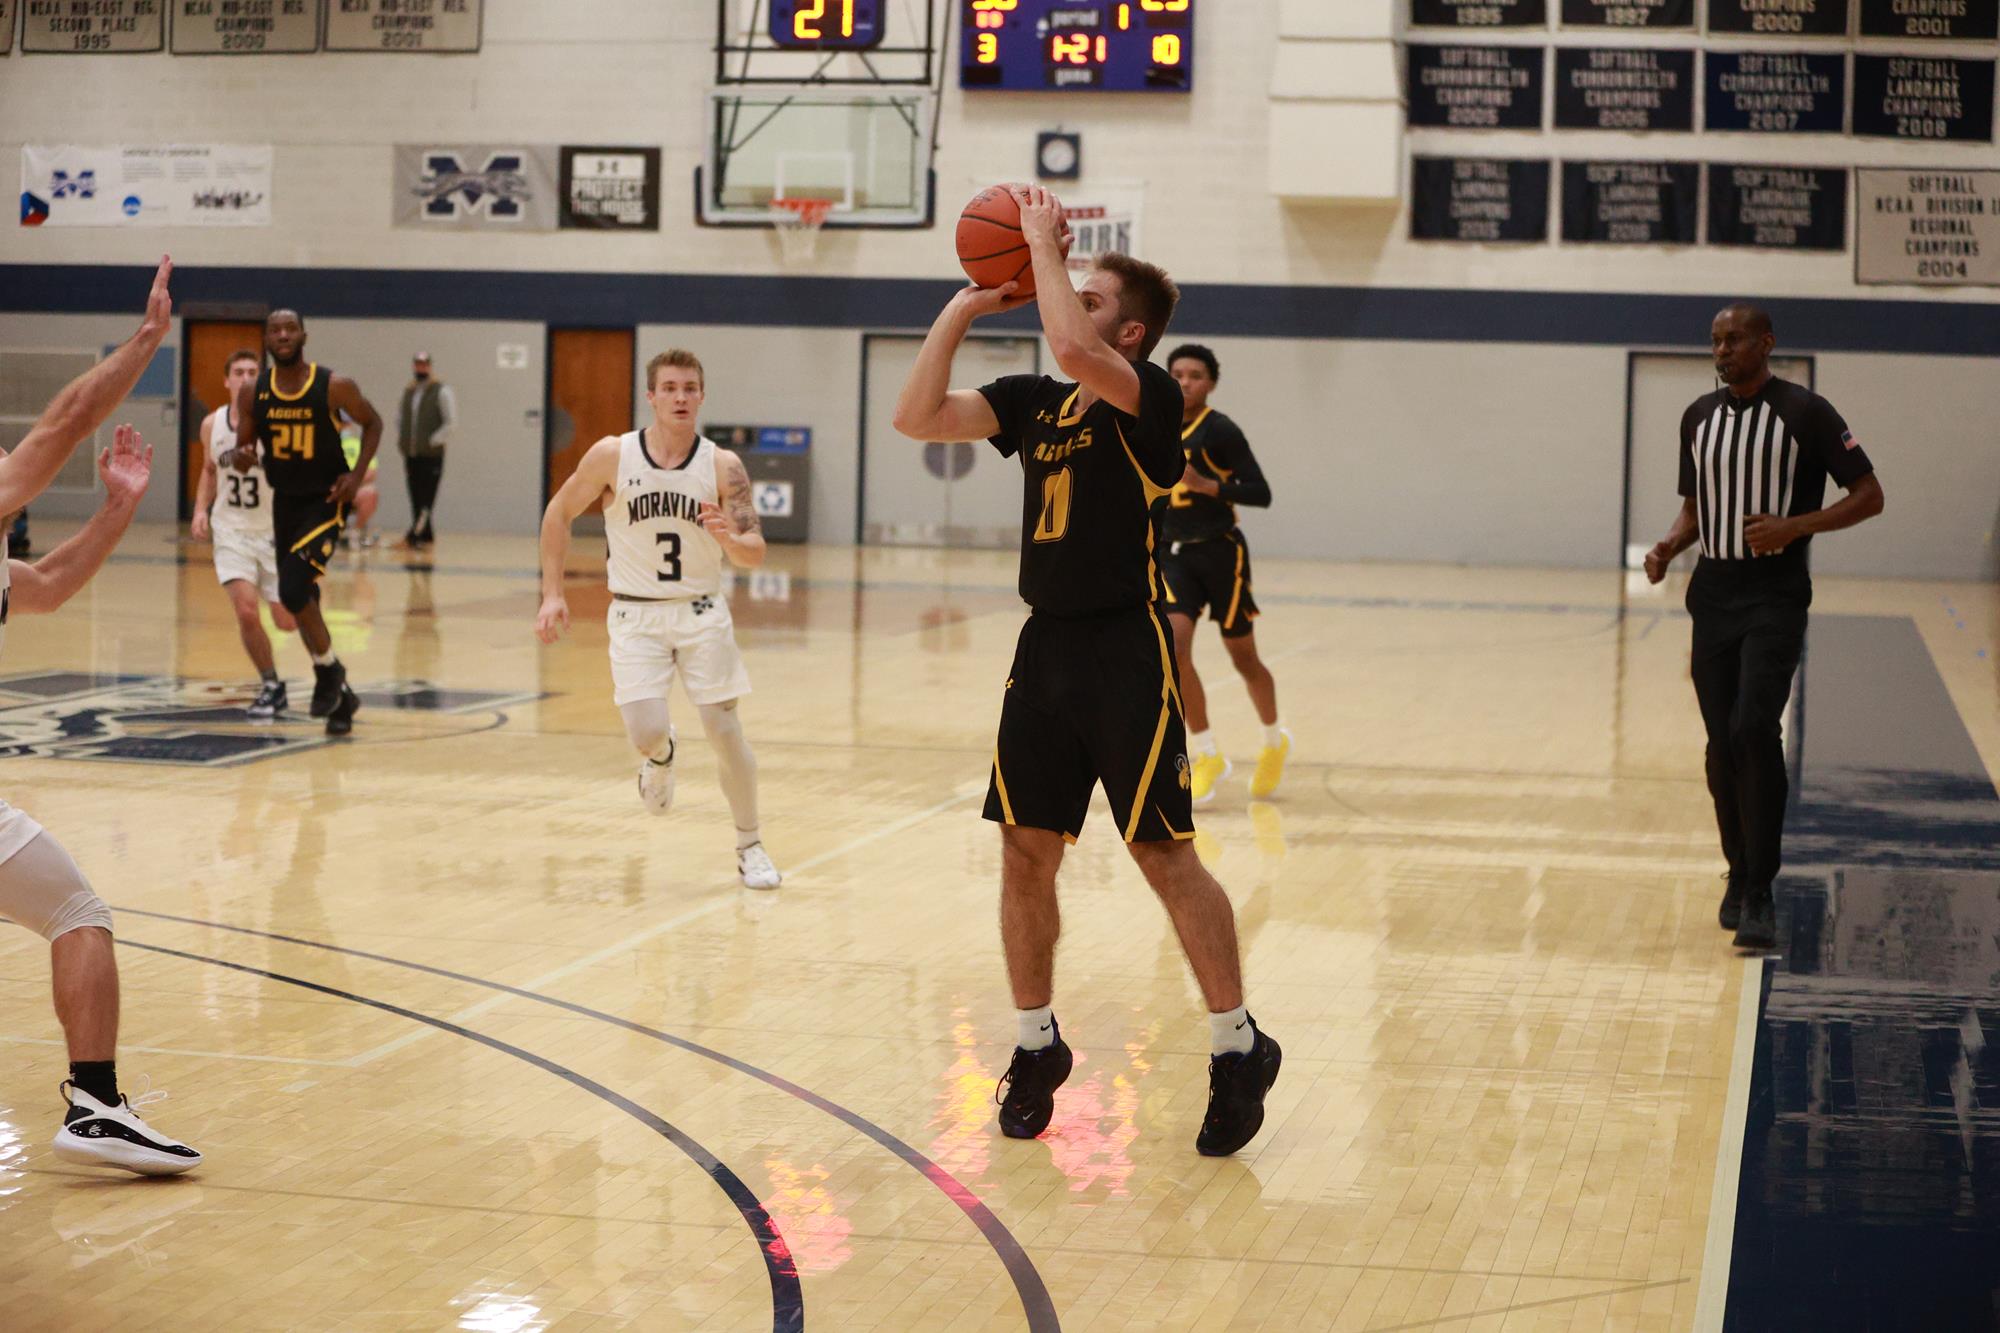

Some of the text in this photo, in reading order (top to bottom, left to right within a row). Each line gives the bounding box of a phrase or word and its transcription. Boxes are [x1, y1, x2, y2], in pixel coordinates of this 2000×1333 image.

[49, 17, 137, 32] SECOND PLACE
[1751, 14, 1803, 32] 2000
[1906, 18, 1952, 36] 2001
[73, 34, 111, 49] 1995
[977, 33, 998, 64] 3
[1152, 34, 1180, 65] 10
[1888, 59, 1960, 80] SOFTBALL
[1887, 80, 1960, 99] LANDMARK
[1883, 99, 1962, 119] CHAMPIONS
[1908, 176, 1977, 193] SOFTBALL
[1875, 196, 1914, 213] NCAA
[1926, 197, 1984, 214] DIVISION
[1910, 219, 1974, 235] REGIONAL
[1069, 221, 1131, 258] ARK
[1905, 240, 1979, 256] CHAMPIONS
[1917, 260, 1968, 277] 2004
[266, 407, 313, 420] AGGIES
[270, 423, 314, 460] 24
[226, 475, 260, 508] 33
[1032, 463, 1073, 543] 0
[655, 532, 682, 582] 3
